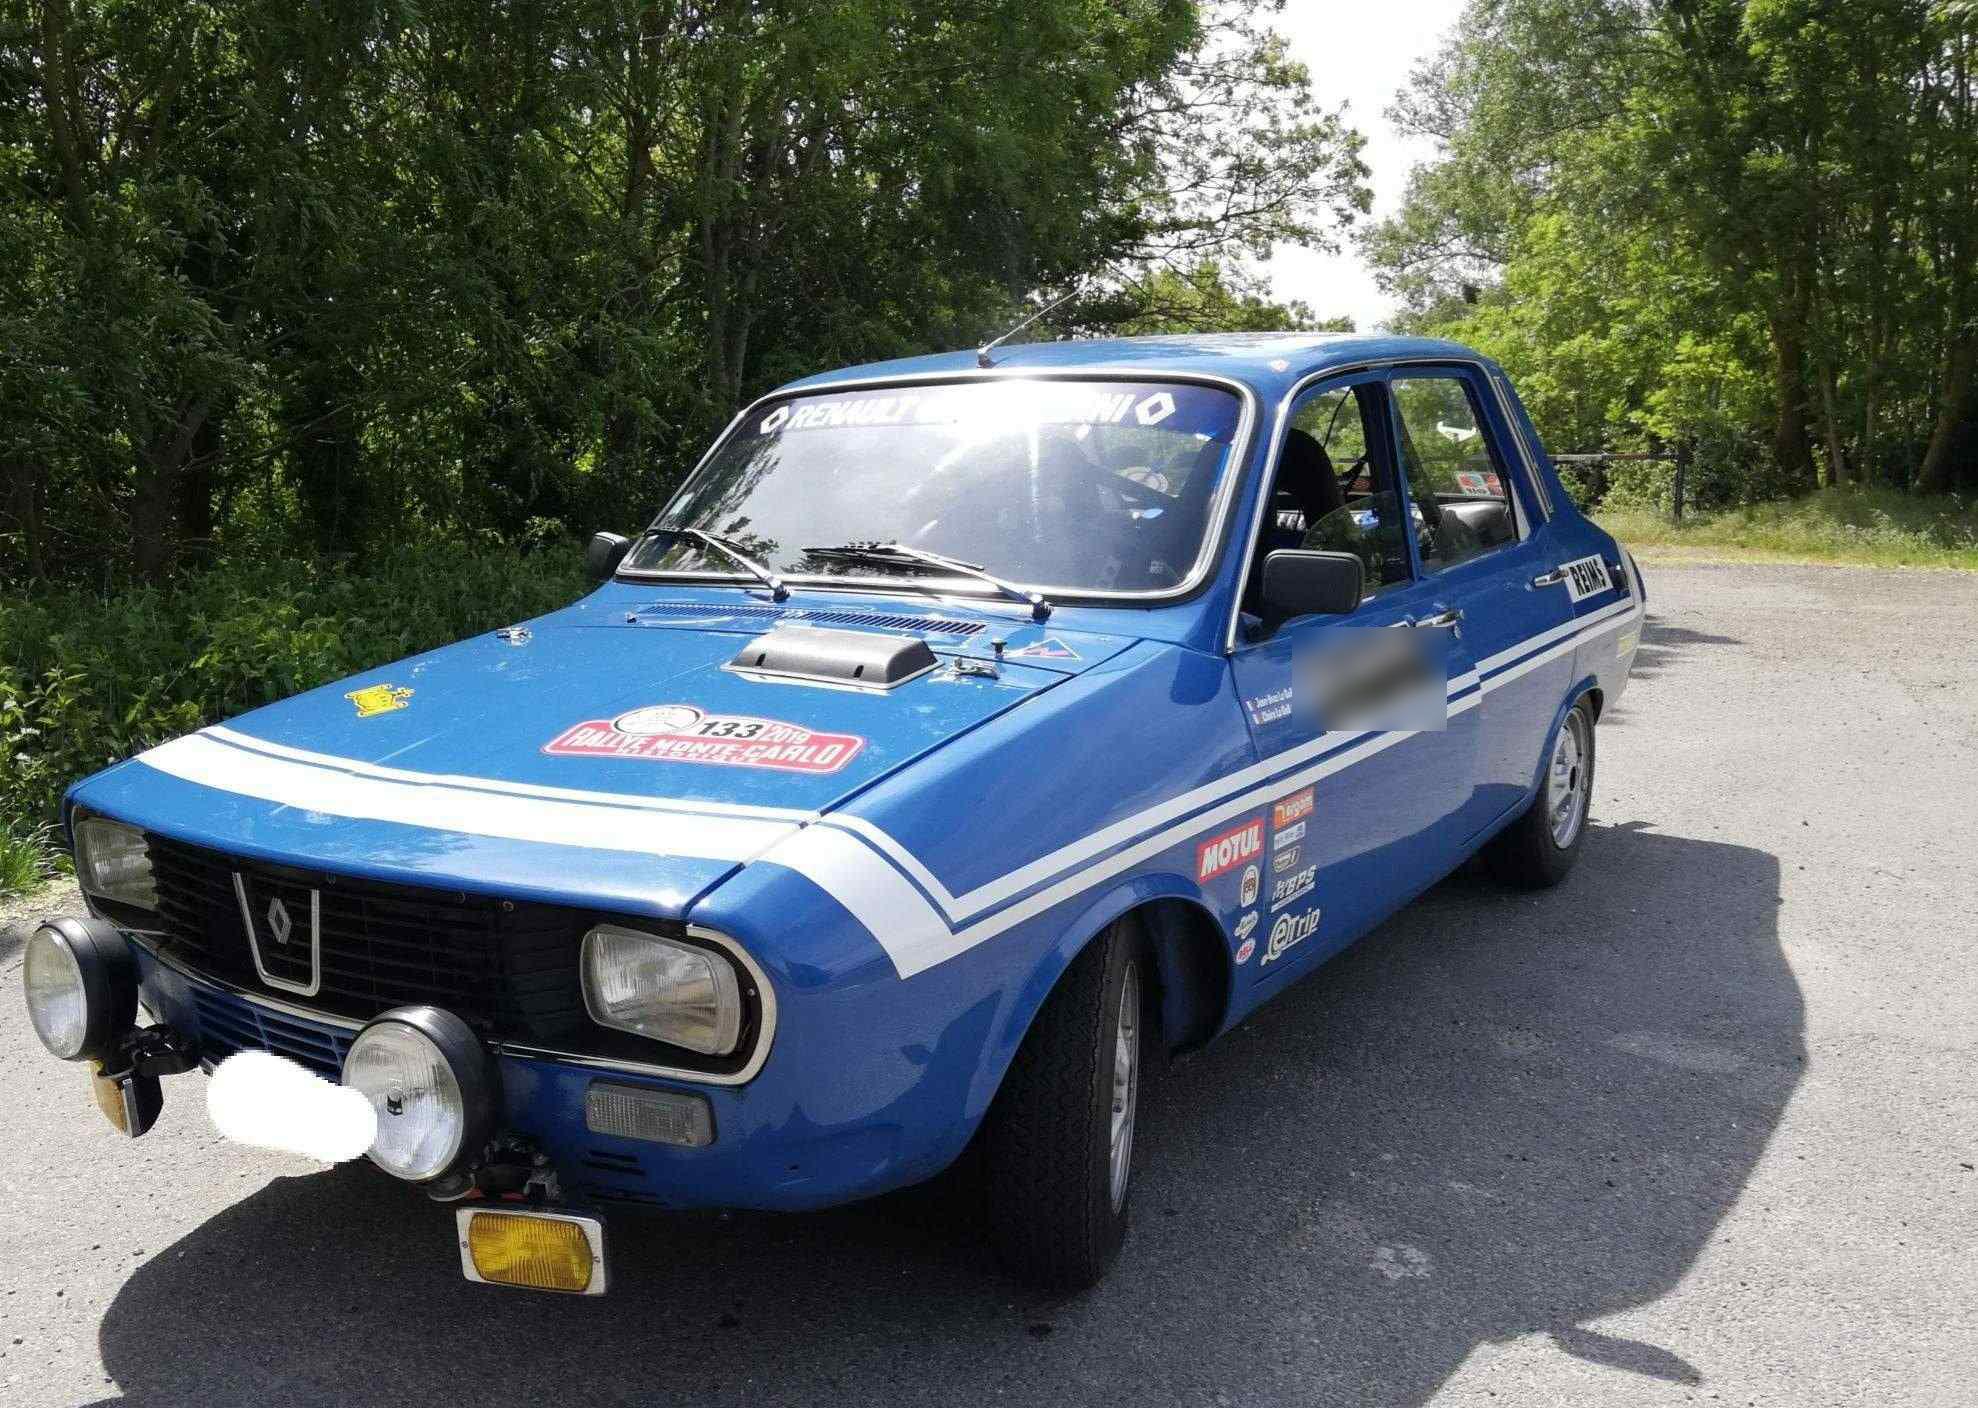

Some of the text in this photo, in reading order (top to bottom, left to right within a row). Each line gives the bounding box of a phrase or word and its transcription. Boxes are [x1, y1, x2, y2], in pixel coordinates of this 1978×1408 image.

[1569, 557, 1607, 597] REIMS
[563, 727, 646, 752] RALLYE
[653, 738, 846, 765] MONTE-CARLO
[698, 721, 765, 738] 133
[1200, 824, 1262, 877] MOTUL
